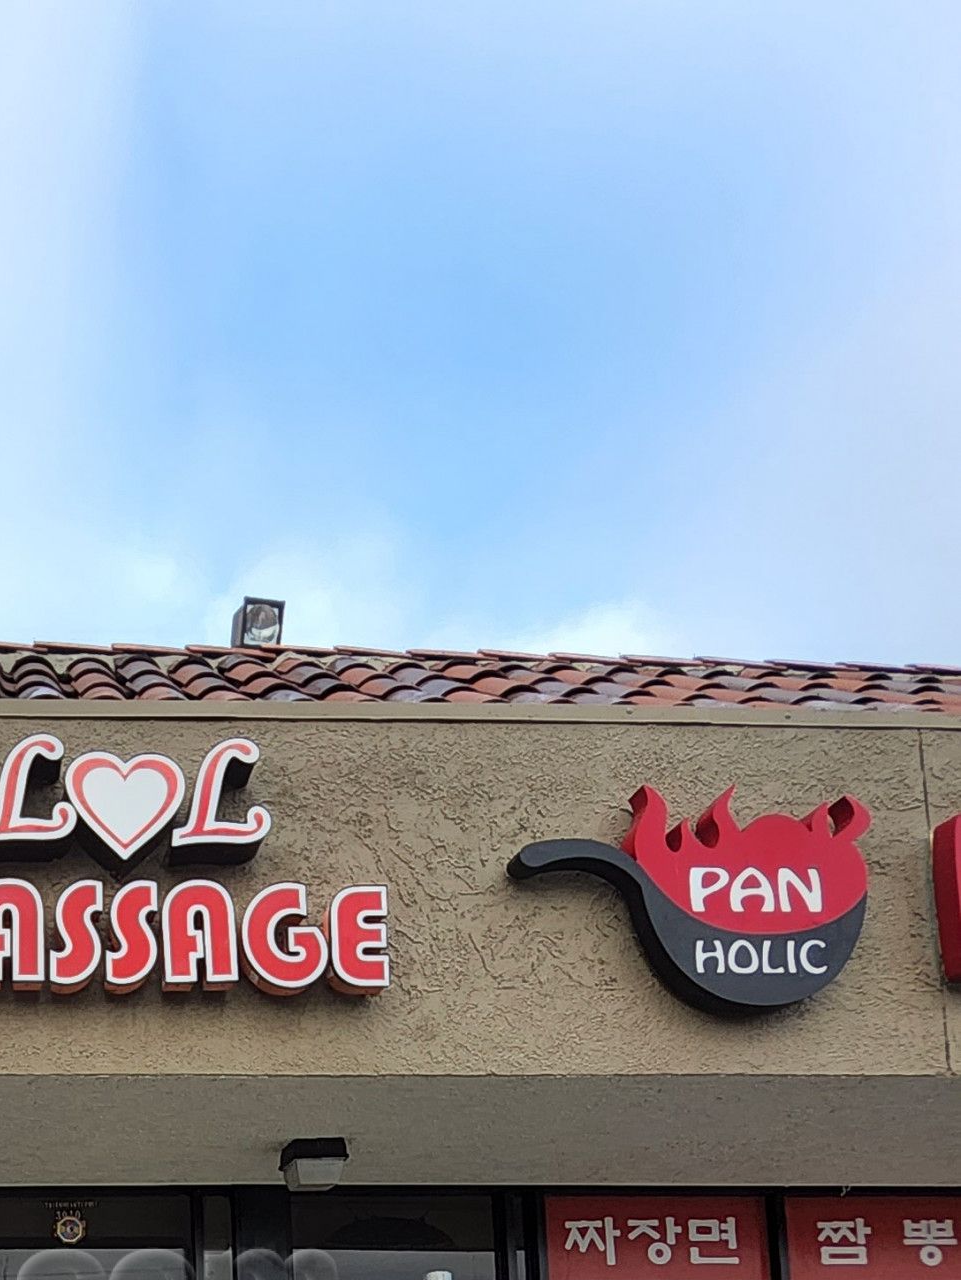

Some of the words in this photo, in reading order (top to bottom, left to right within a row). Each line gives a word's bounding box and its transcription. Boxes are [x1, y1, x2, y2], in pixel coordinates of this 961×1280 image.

[689, 867, 823, 912] PAN
[696, 940, 828, 975] HOLIC
[564, 1216, 740, 1265] 짜장면
